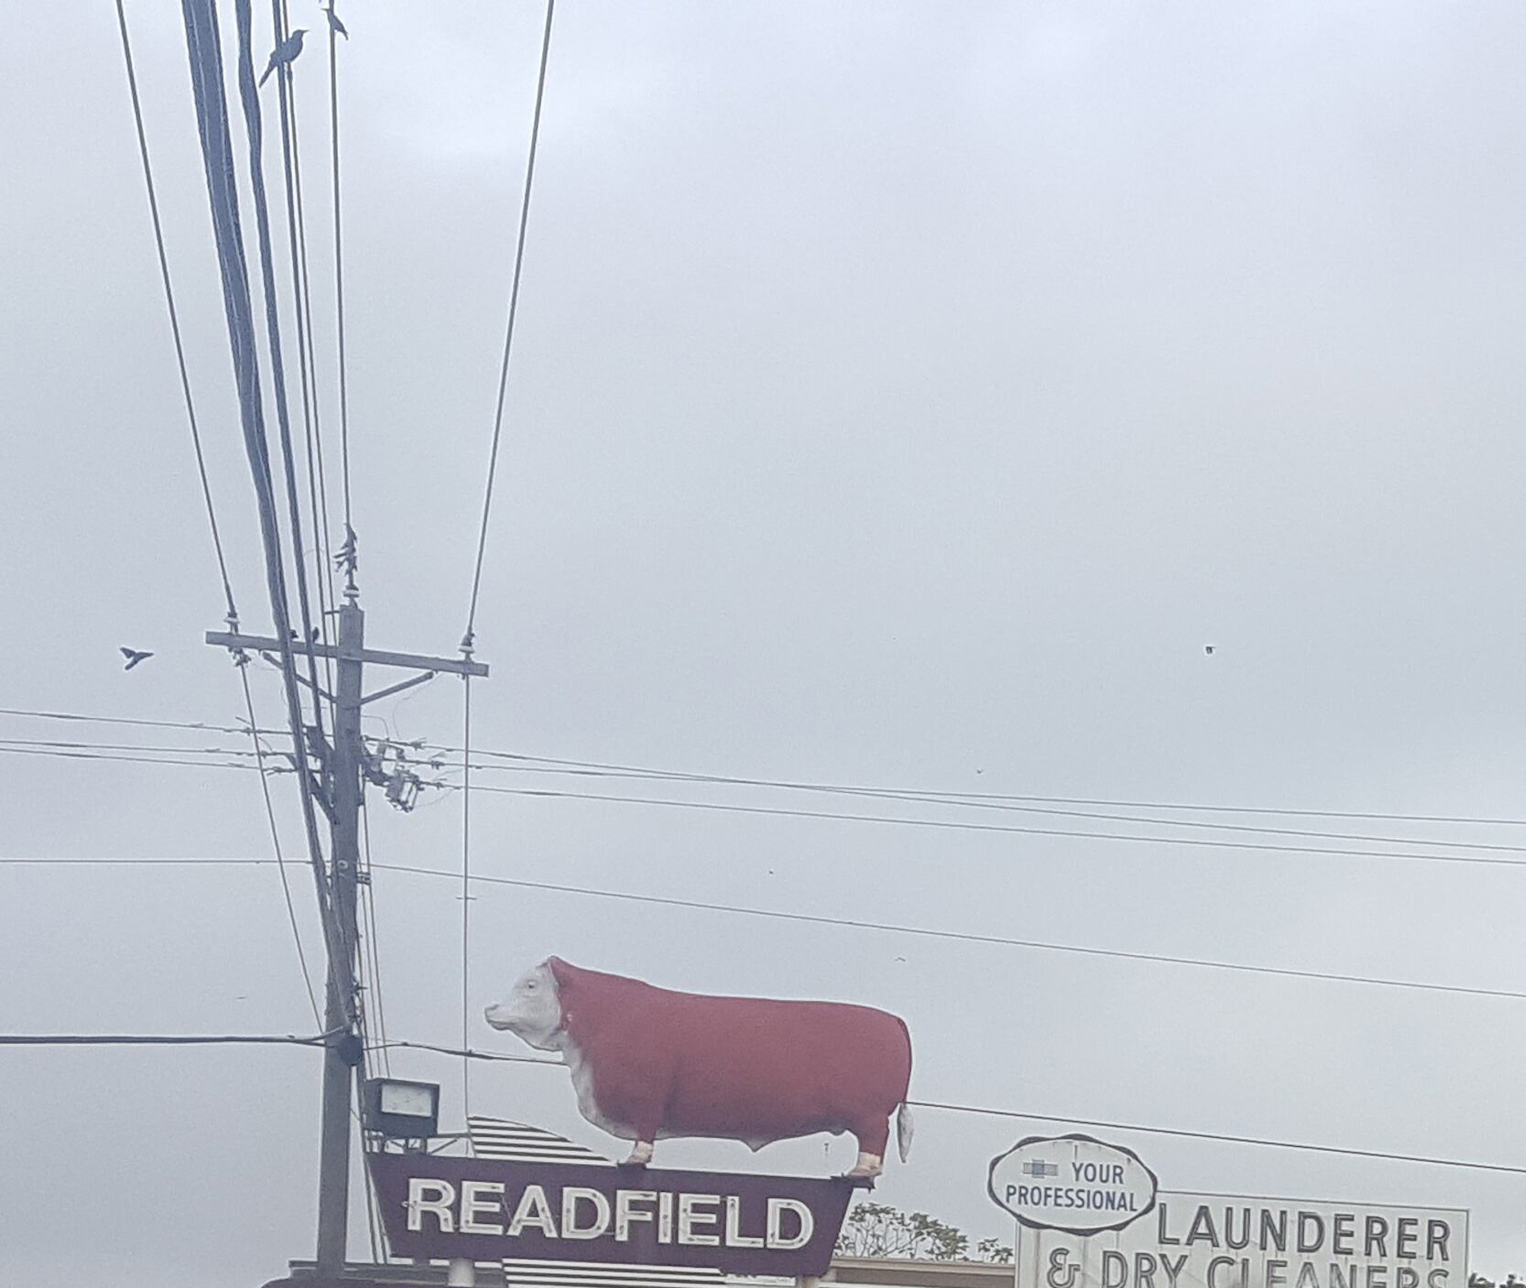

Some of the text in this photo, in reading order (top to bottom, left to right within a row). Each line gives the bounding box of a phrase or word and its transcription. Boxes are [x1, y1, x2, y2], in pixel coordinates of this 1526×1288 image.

[1072, 1161, 1125, 1185] YOUR
[406, 1177, 816, 1250] READFIELD
[1005, 1184, 1139, 1213] PROFESSIONAL
[1157, 1202, 1451, 1262] LAUNDERER
